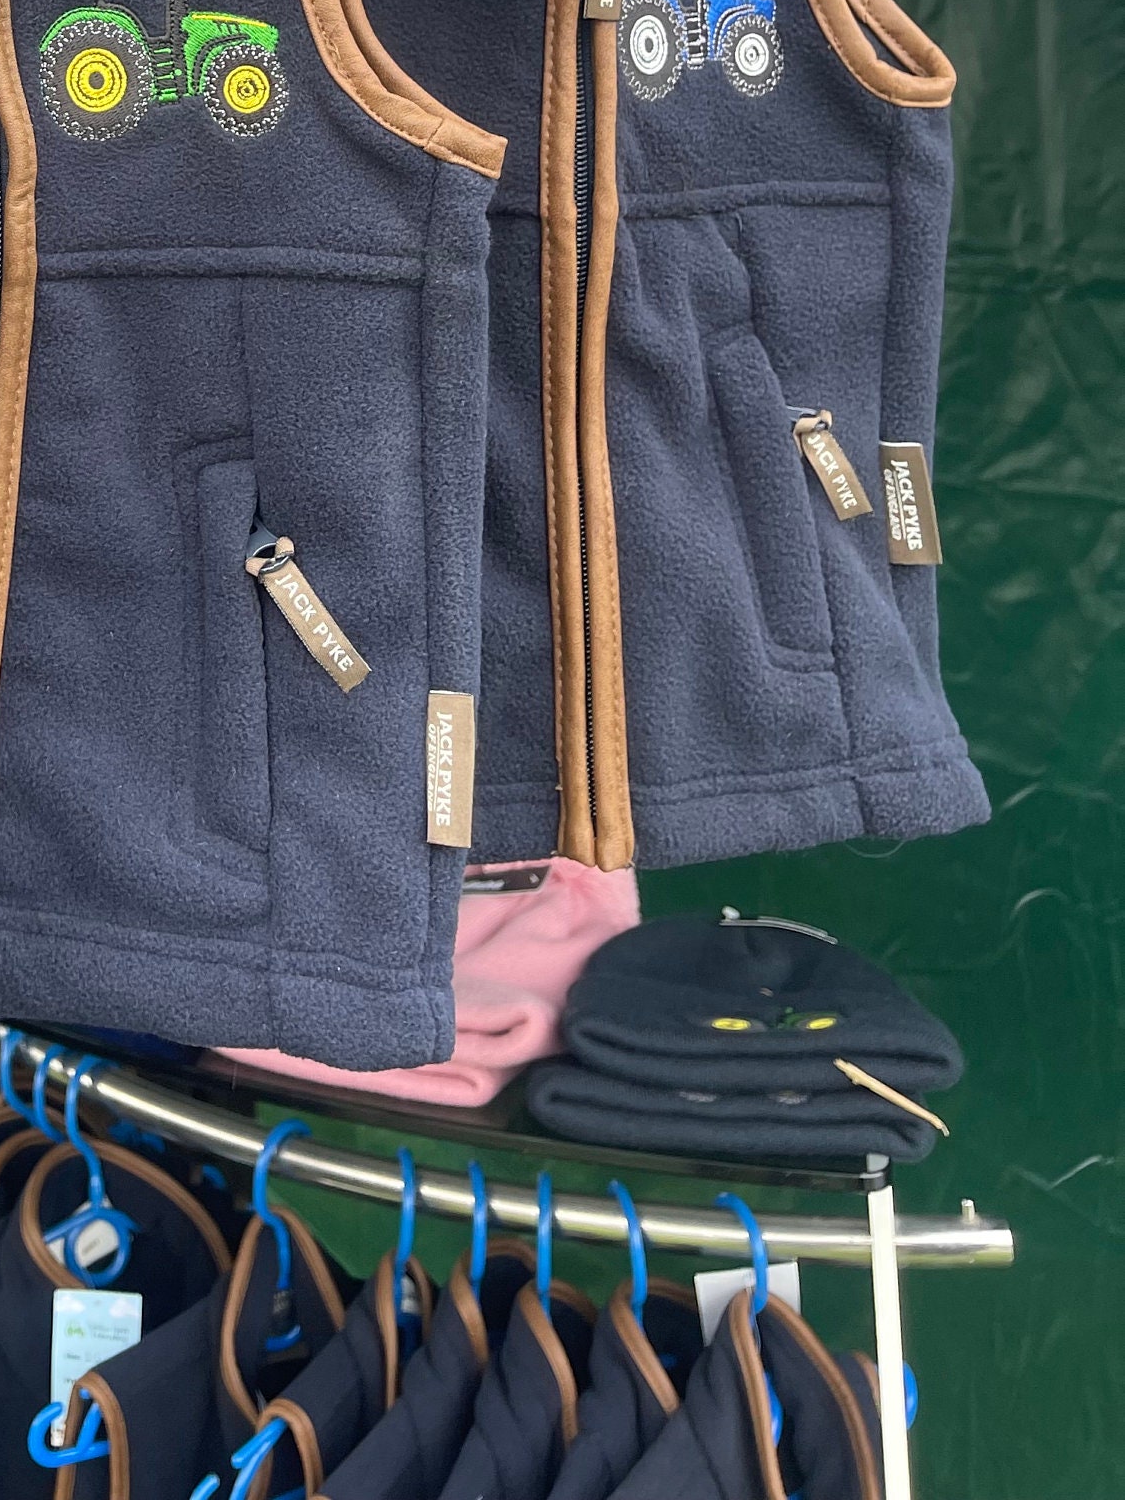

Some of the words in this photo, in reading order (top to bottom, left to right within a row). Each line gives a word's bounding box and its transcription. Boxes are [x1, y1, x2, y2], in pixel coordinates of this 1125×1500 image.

[807, 434, 840, 476] JACK
[832, 474, 858, 510] PYKE
[890, 459, 915, 502] JACK
[902, 503, 923, 551] PYKE
[275, 573, 317, 622] JACK
[313, 622, 354, 672] PYKE
[436, 711, 453, 766] JACK
[435, 769, 452, 827] PYKE
